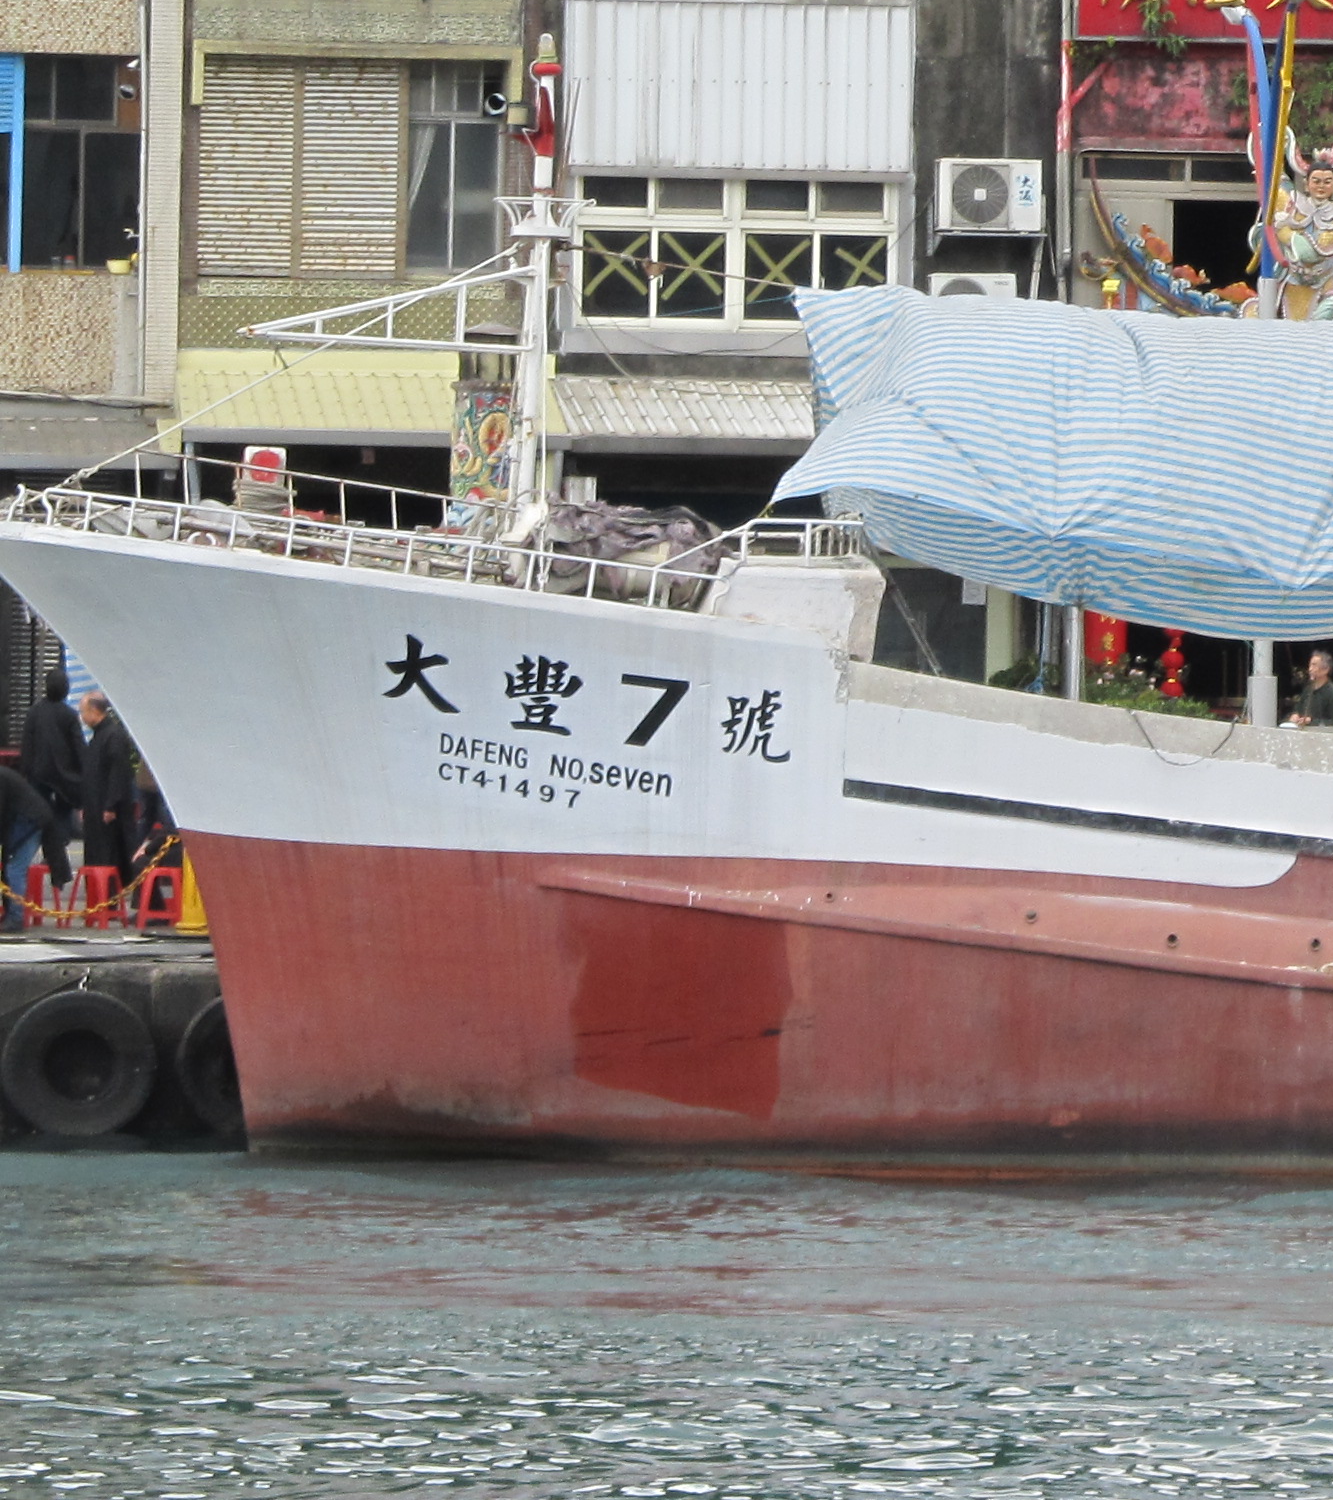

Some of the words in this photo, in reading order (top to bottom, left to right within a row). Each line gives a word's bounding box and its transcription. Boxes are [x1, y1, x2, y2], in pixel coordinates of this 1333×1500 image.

[382, 633, 790, 763] 大豐7號
[440, 732, 528, 769] DAFENG
[438, 762, 581, 808] CT4-1497
